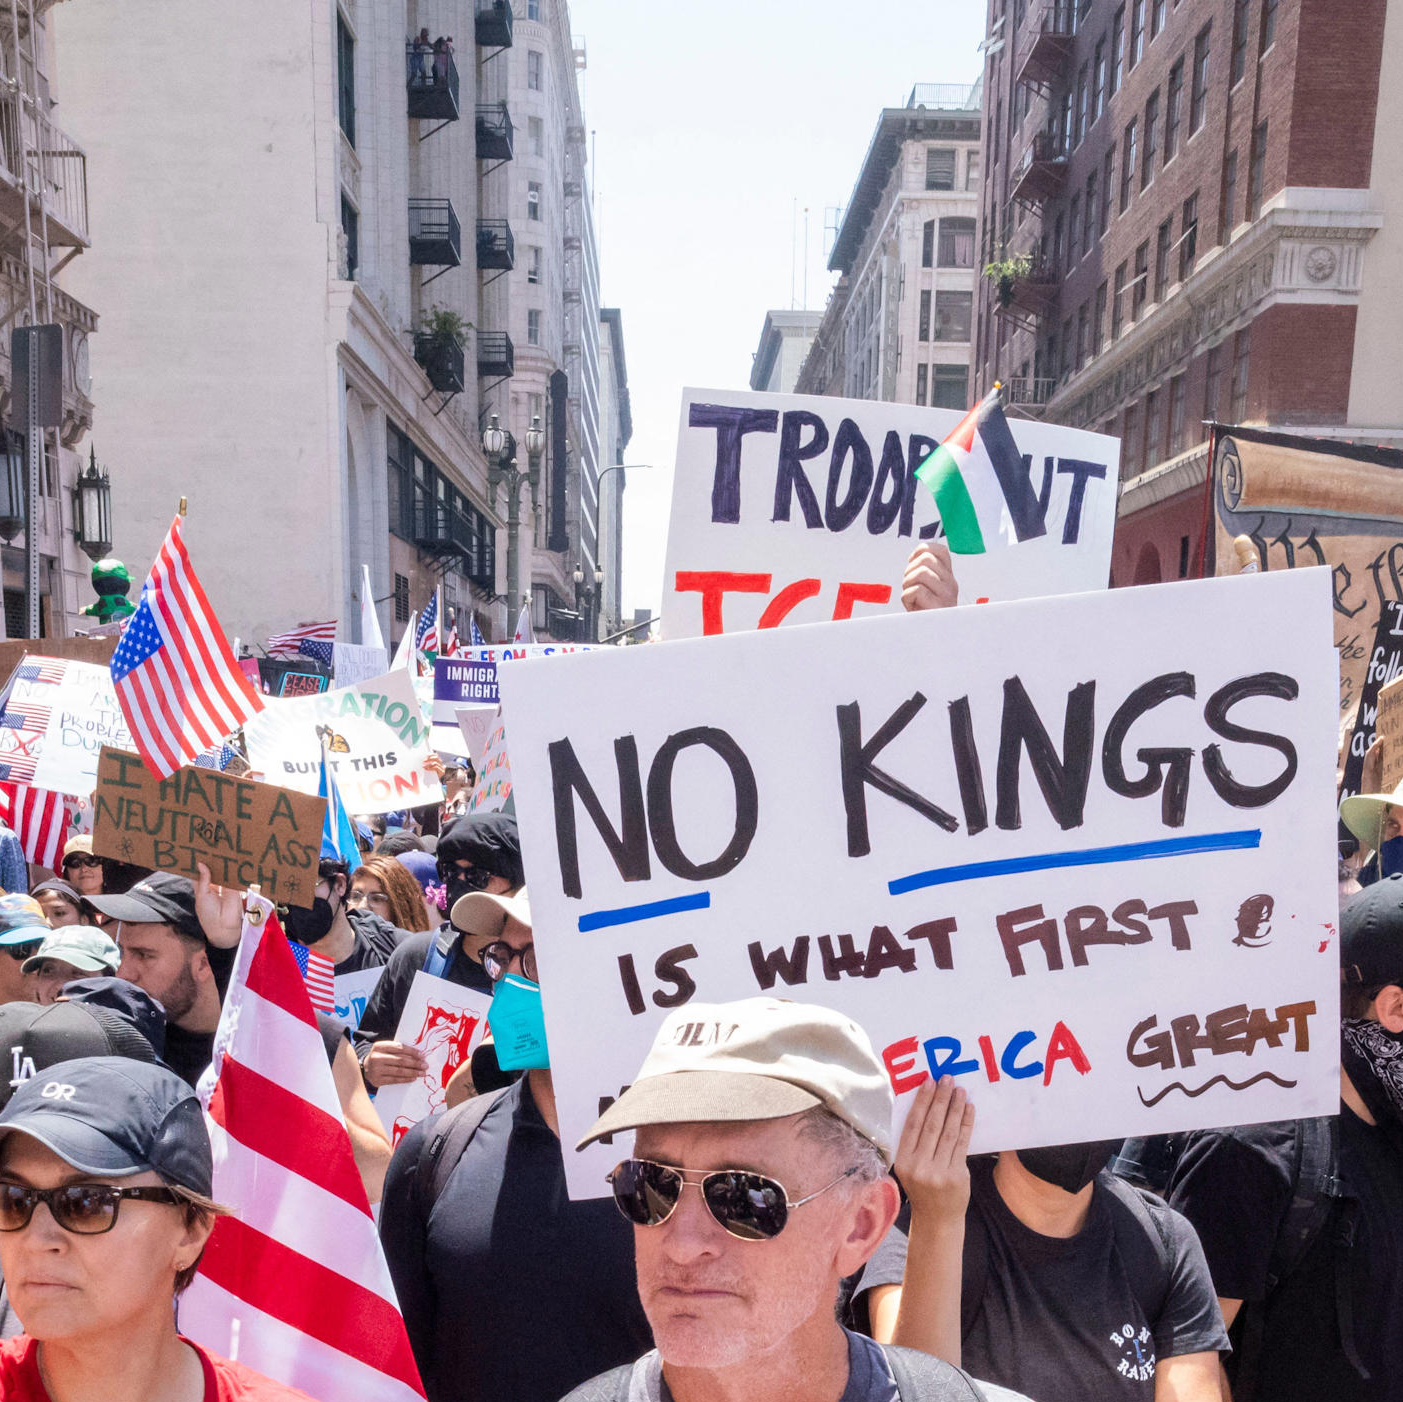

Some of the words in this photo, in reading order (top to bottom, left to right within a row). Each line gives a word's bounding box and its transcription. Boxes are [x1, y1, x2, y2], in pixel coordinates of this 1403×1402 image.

[1022, 453, 1107, 545] UT
[285, 675, 320, 691] CEASE
[282, 759, 339, 774] BUIT
[350, 751, 398, 772] THIS
[549, 724, 760, 901] NO
[836, 671, 1301, 858] KINGS
[103, 752, 145, 789] I
[160, 769, 254, 820] HATE
[272, 788, 298, 831] A
[152, 838, 279, 894] BITCH
[258, 831, 319, 870] ASS
[617, 943, 699, 1016] IS
[747, 916, 958, 991] WHAT
[996, 899, 1199, 977] FIRST
[9, 1046, 38, 1088] LA
[883, 1020, 1093, 1098] ERICA
[1126, 1000, 1318, 1071] GREAT
[41, 1081, 77, 1101] OR
